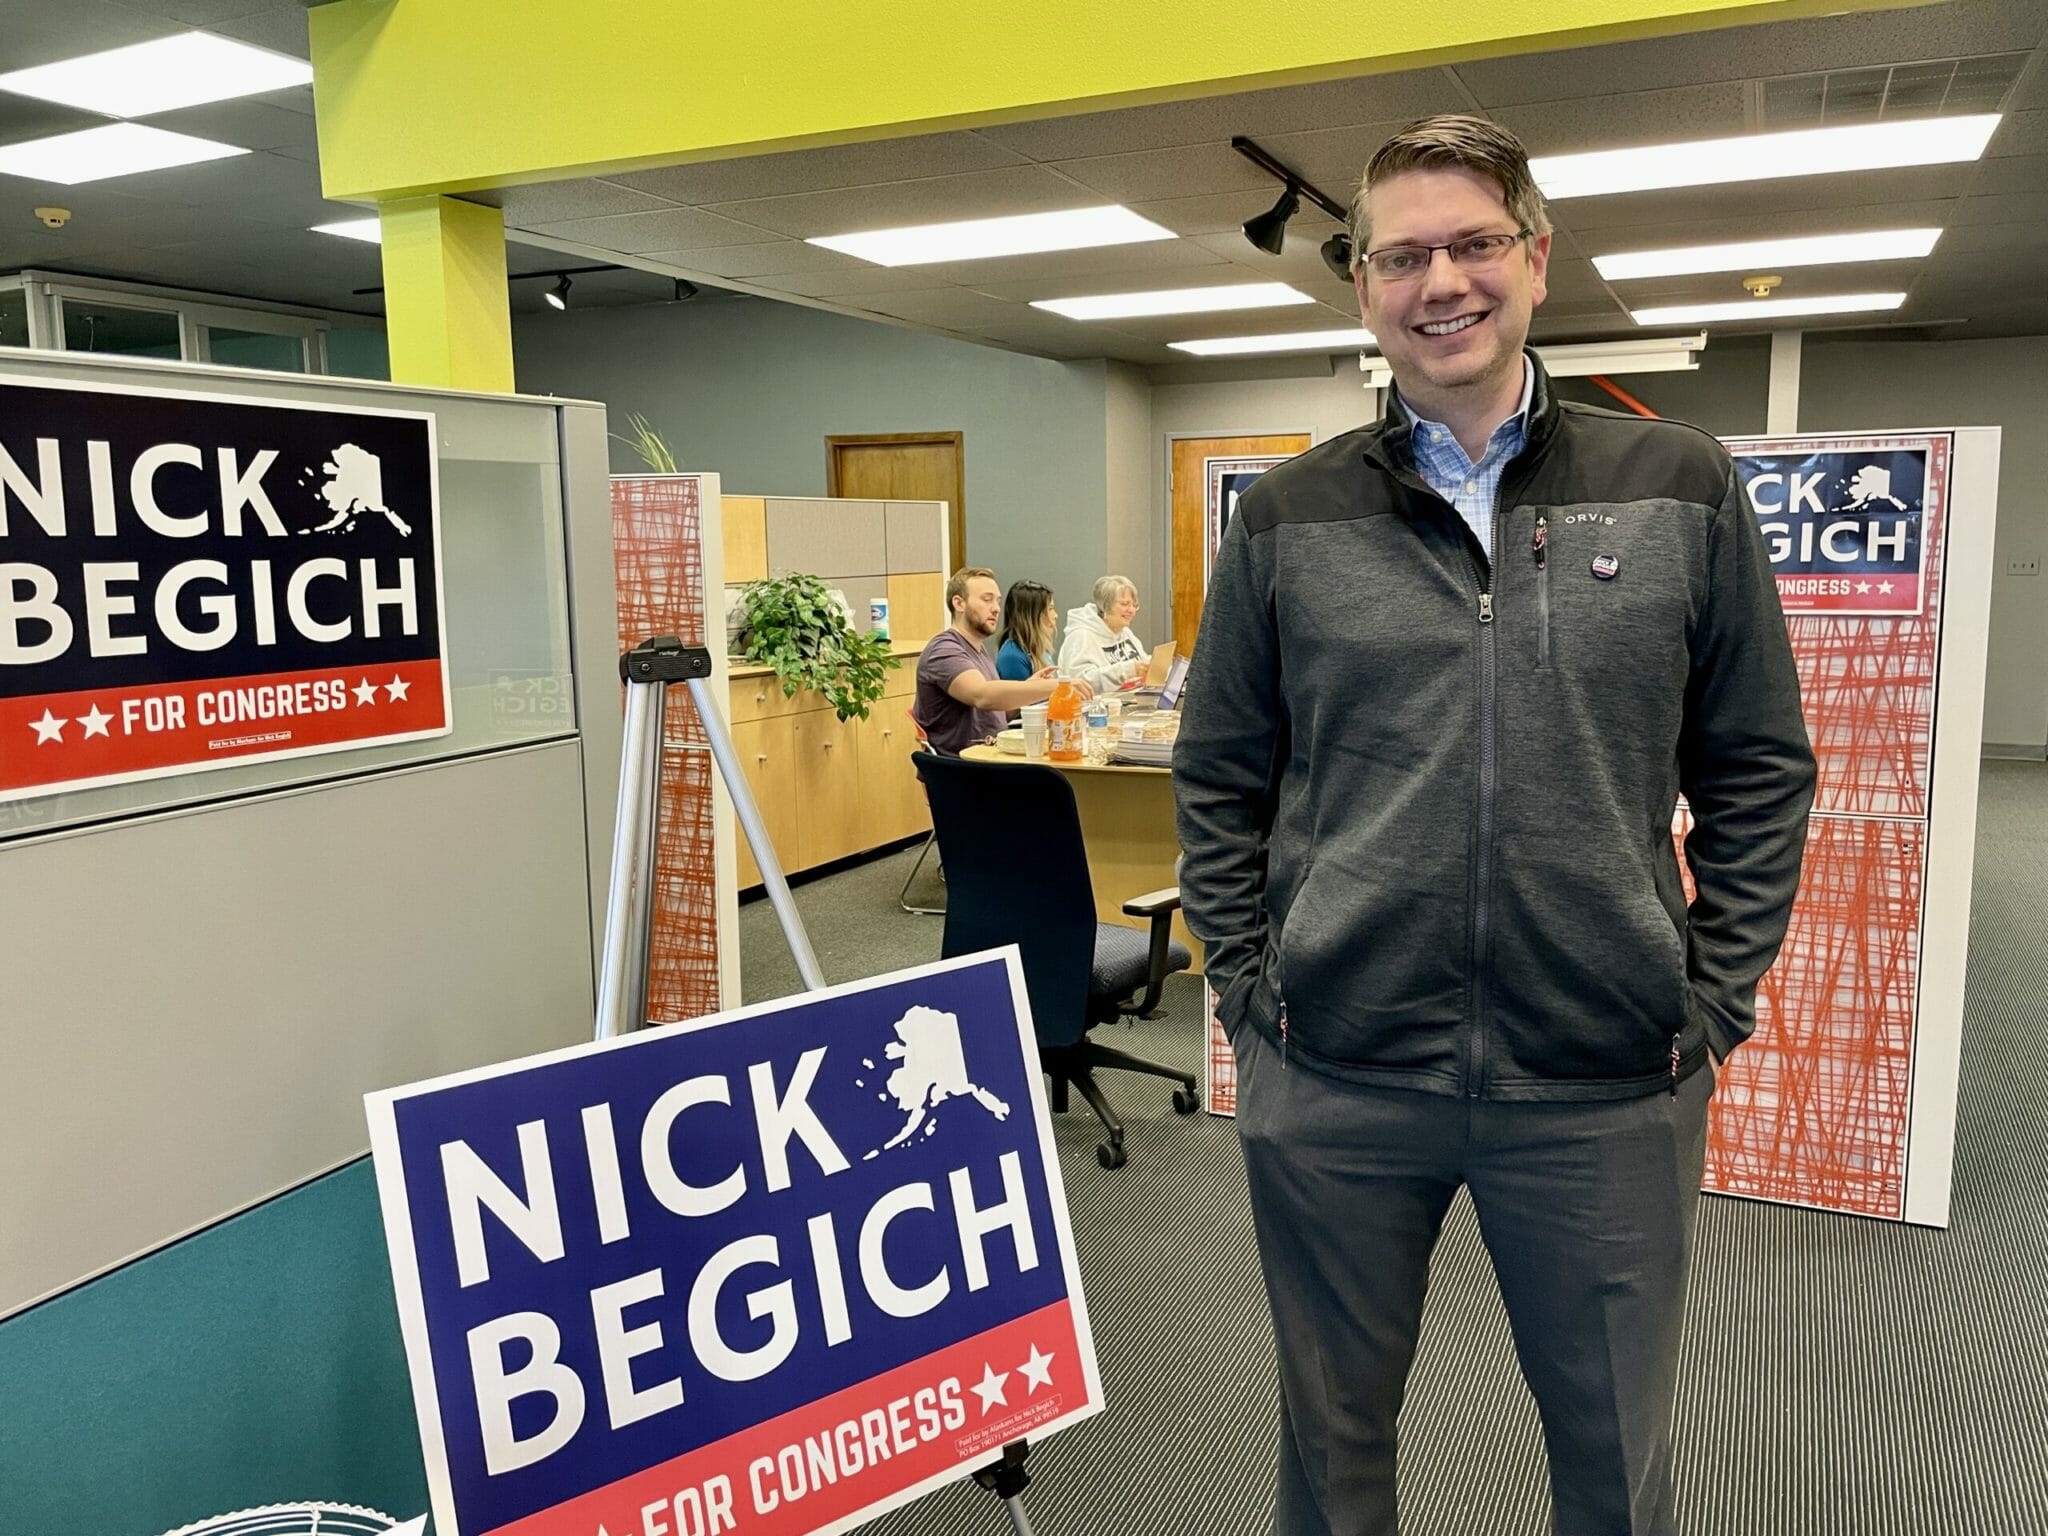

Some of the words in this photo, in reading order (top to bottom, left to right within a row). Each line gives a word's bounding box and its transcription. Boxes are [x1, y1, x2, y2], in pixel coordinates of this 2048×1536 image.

[0, 438, 288, 537] NICK
[1745, 472, 1827, 514] CK
[1565, 513, 1615, 525] ORVIS
[1760, 520, 1907, 563] GICH
[0, 558, 418, 665] BEGICH
[1776, 579, 1851, 596] ONGRESS
[122, 695, 186, 735] FOR
[199, 680, 347, 723] CONGRESS
[440, 1046, 851, 1288] NICK
[467, 1151, 1039, 1477] BEGICH
[959, 1436, 971, 1447] Paid
[972, 1432, 981, 1441] for
[982, 1430, 989, 1438] by
[1023, 1407, 1036, 1418] Nick
[969, 1445, 980, 1454] Box
[641, 1474, 737, 1536] FOR
[749, 1377, 967, 1516] CONGRESS
